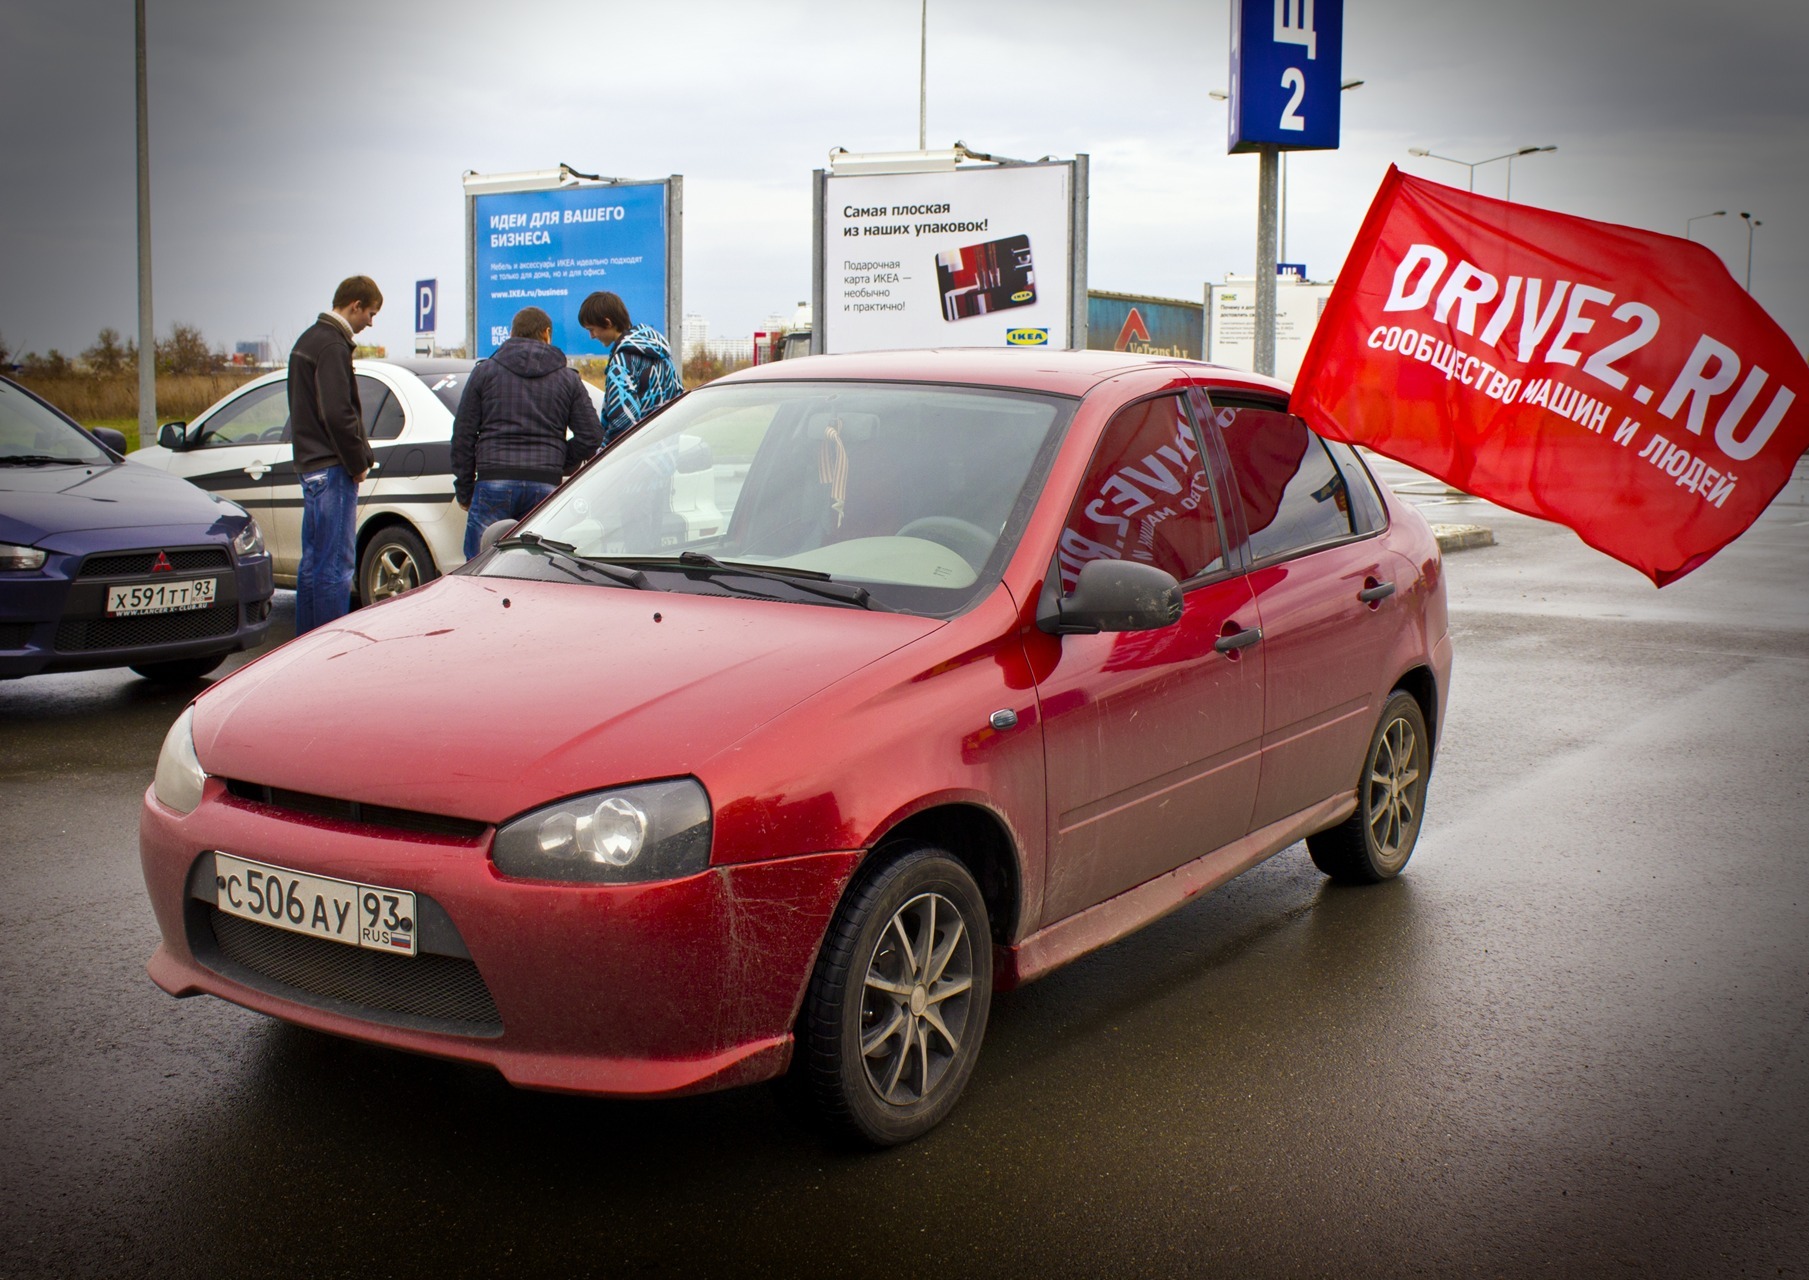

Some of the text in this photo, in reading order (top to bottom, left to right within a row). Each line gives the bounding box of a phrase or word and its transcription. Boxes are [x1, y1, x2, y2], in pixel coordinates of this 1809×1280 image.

[1279, 67, 1305, 131] 2
[490, 206, 625, 230] ИДЕИ ДЛЯ ВАШЕГО
[843, 203, 951, 218] Самая плоская
[843, 218, 989, 237] из наших упаковок!
[490, 230, 551, 248] БИЗНЕСА
[490, 263, 512, 271] Мебель
[519, 261, 555, 270] аксессуары
[577, 258, 609, 266] идеально
[610, 256, 643, 264] подходят
[844, 260, 900, 272] Подарочная
[520, 272, 532, 280] для
[844, 275, 870, 286] карта
[873, 273, 900, 284] ИКЕА
[490, 288, 569, 299] www.IKEA.ru/business
[844, 288, 890, 298] необычно
[420, 287, 433, 329] P
[844, 301, 906, 312] и практично!
[491, 326, 508, 337] IKEA
[1129, 342, 1171, 357] VeTrans
[1382, 243, 1796, 461] DRIVE2.RU
[1367, 325, 1740, 508] СООБЩЕСТВО МАШИН И ЛЮДЕЙ
[194, 581, 211, 597] 93
[363, 892, 401, 931] 93
[362, 928, 390, 944] RUS
